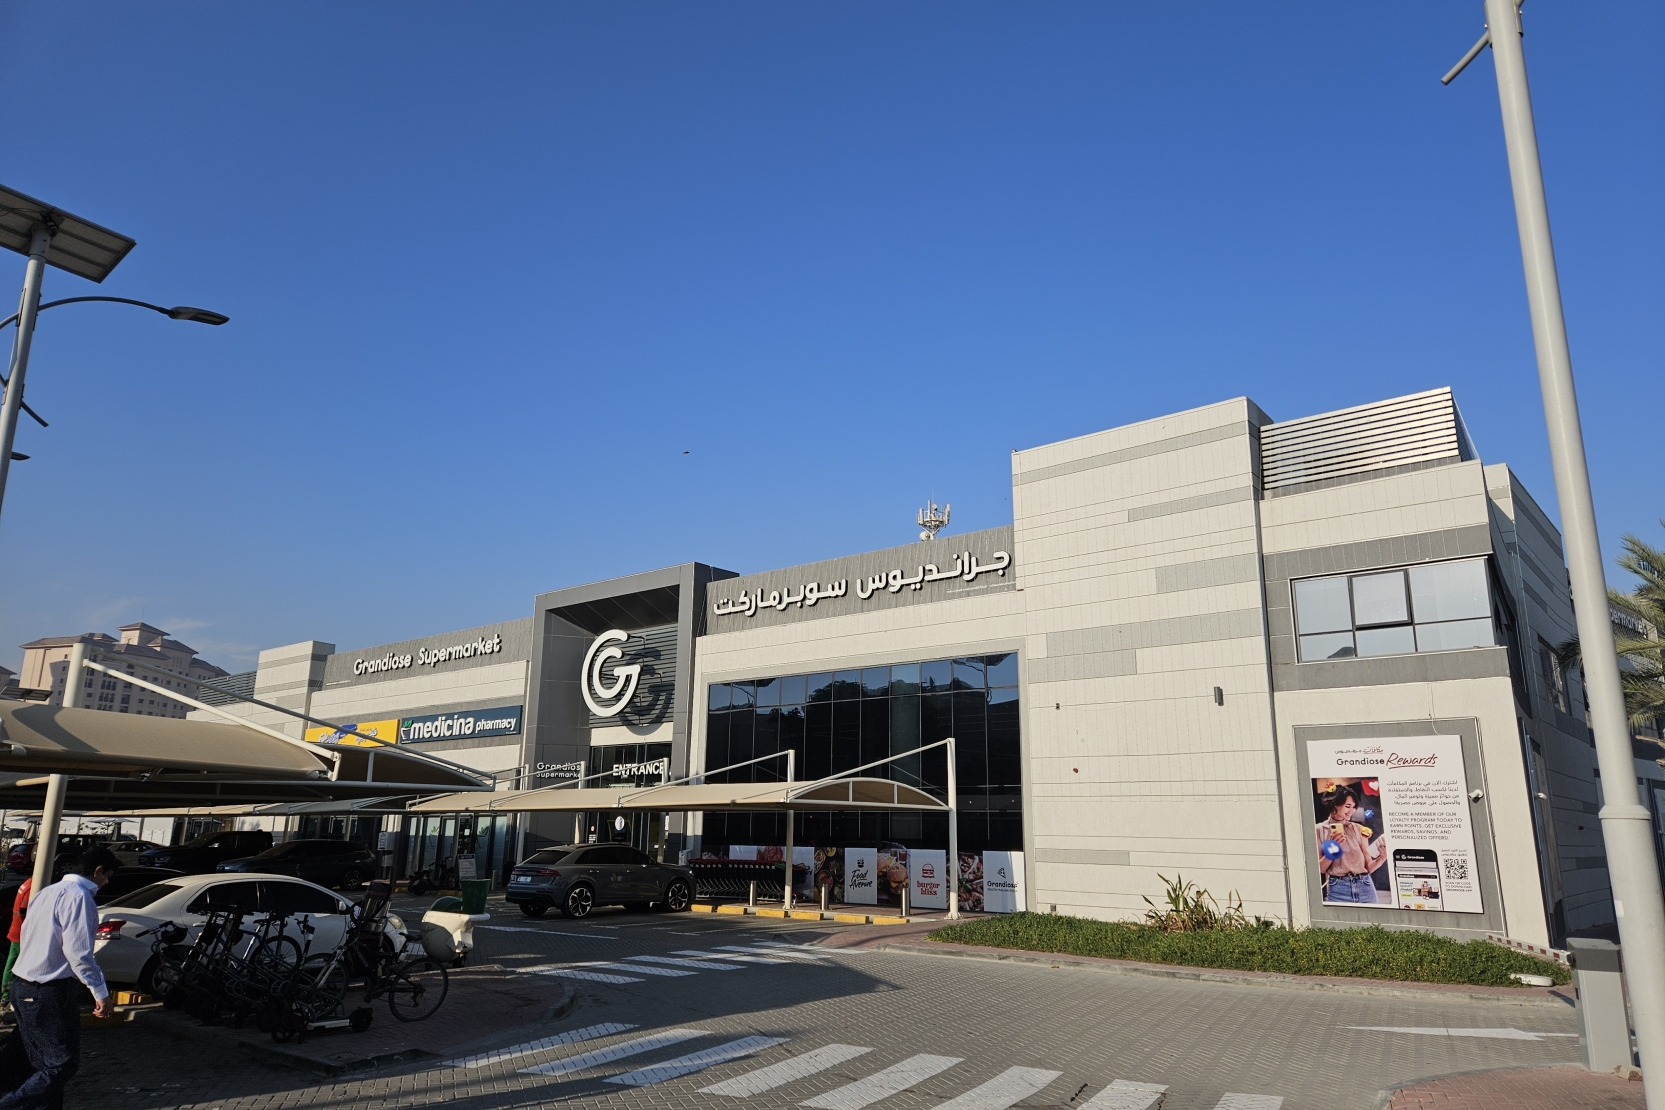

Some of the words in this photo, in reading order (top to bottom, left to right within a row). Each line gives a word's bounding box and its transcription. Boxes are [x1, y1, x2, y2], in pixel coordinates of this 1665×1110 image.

[856, 550, 1011, 599] جرانديوس
[713, 578, 847, 616] سوبرماركت
[353, 652, 411, 675] Grandiose
[418, 634, 501, 666] Supermarket
[410, 716, 473, 739] medicina
[475, 718, 517, 734] pharmacy
[536, 762, 581, 771] Grandios
[1336, 757, 1385, 766] Grandiose
[1386, 753, 1438, 768] Rewards
[612, 762, 664, 776] ENTRANCE
[851, 869, 869, 881] Food
[849, 880, 873, 890] Avenue
[916, 880, 940, 890] burger
[920, 887, 938, 896] bliss
